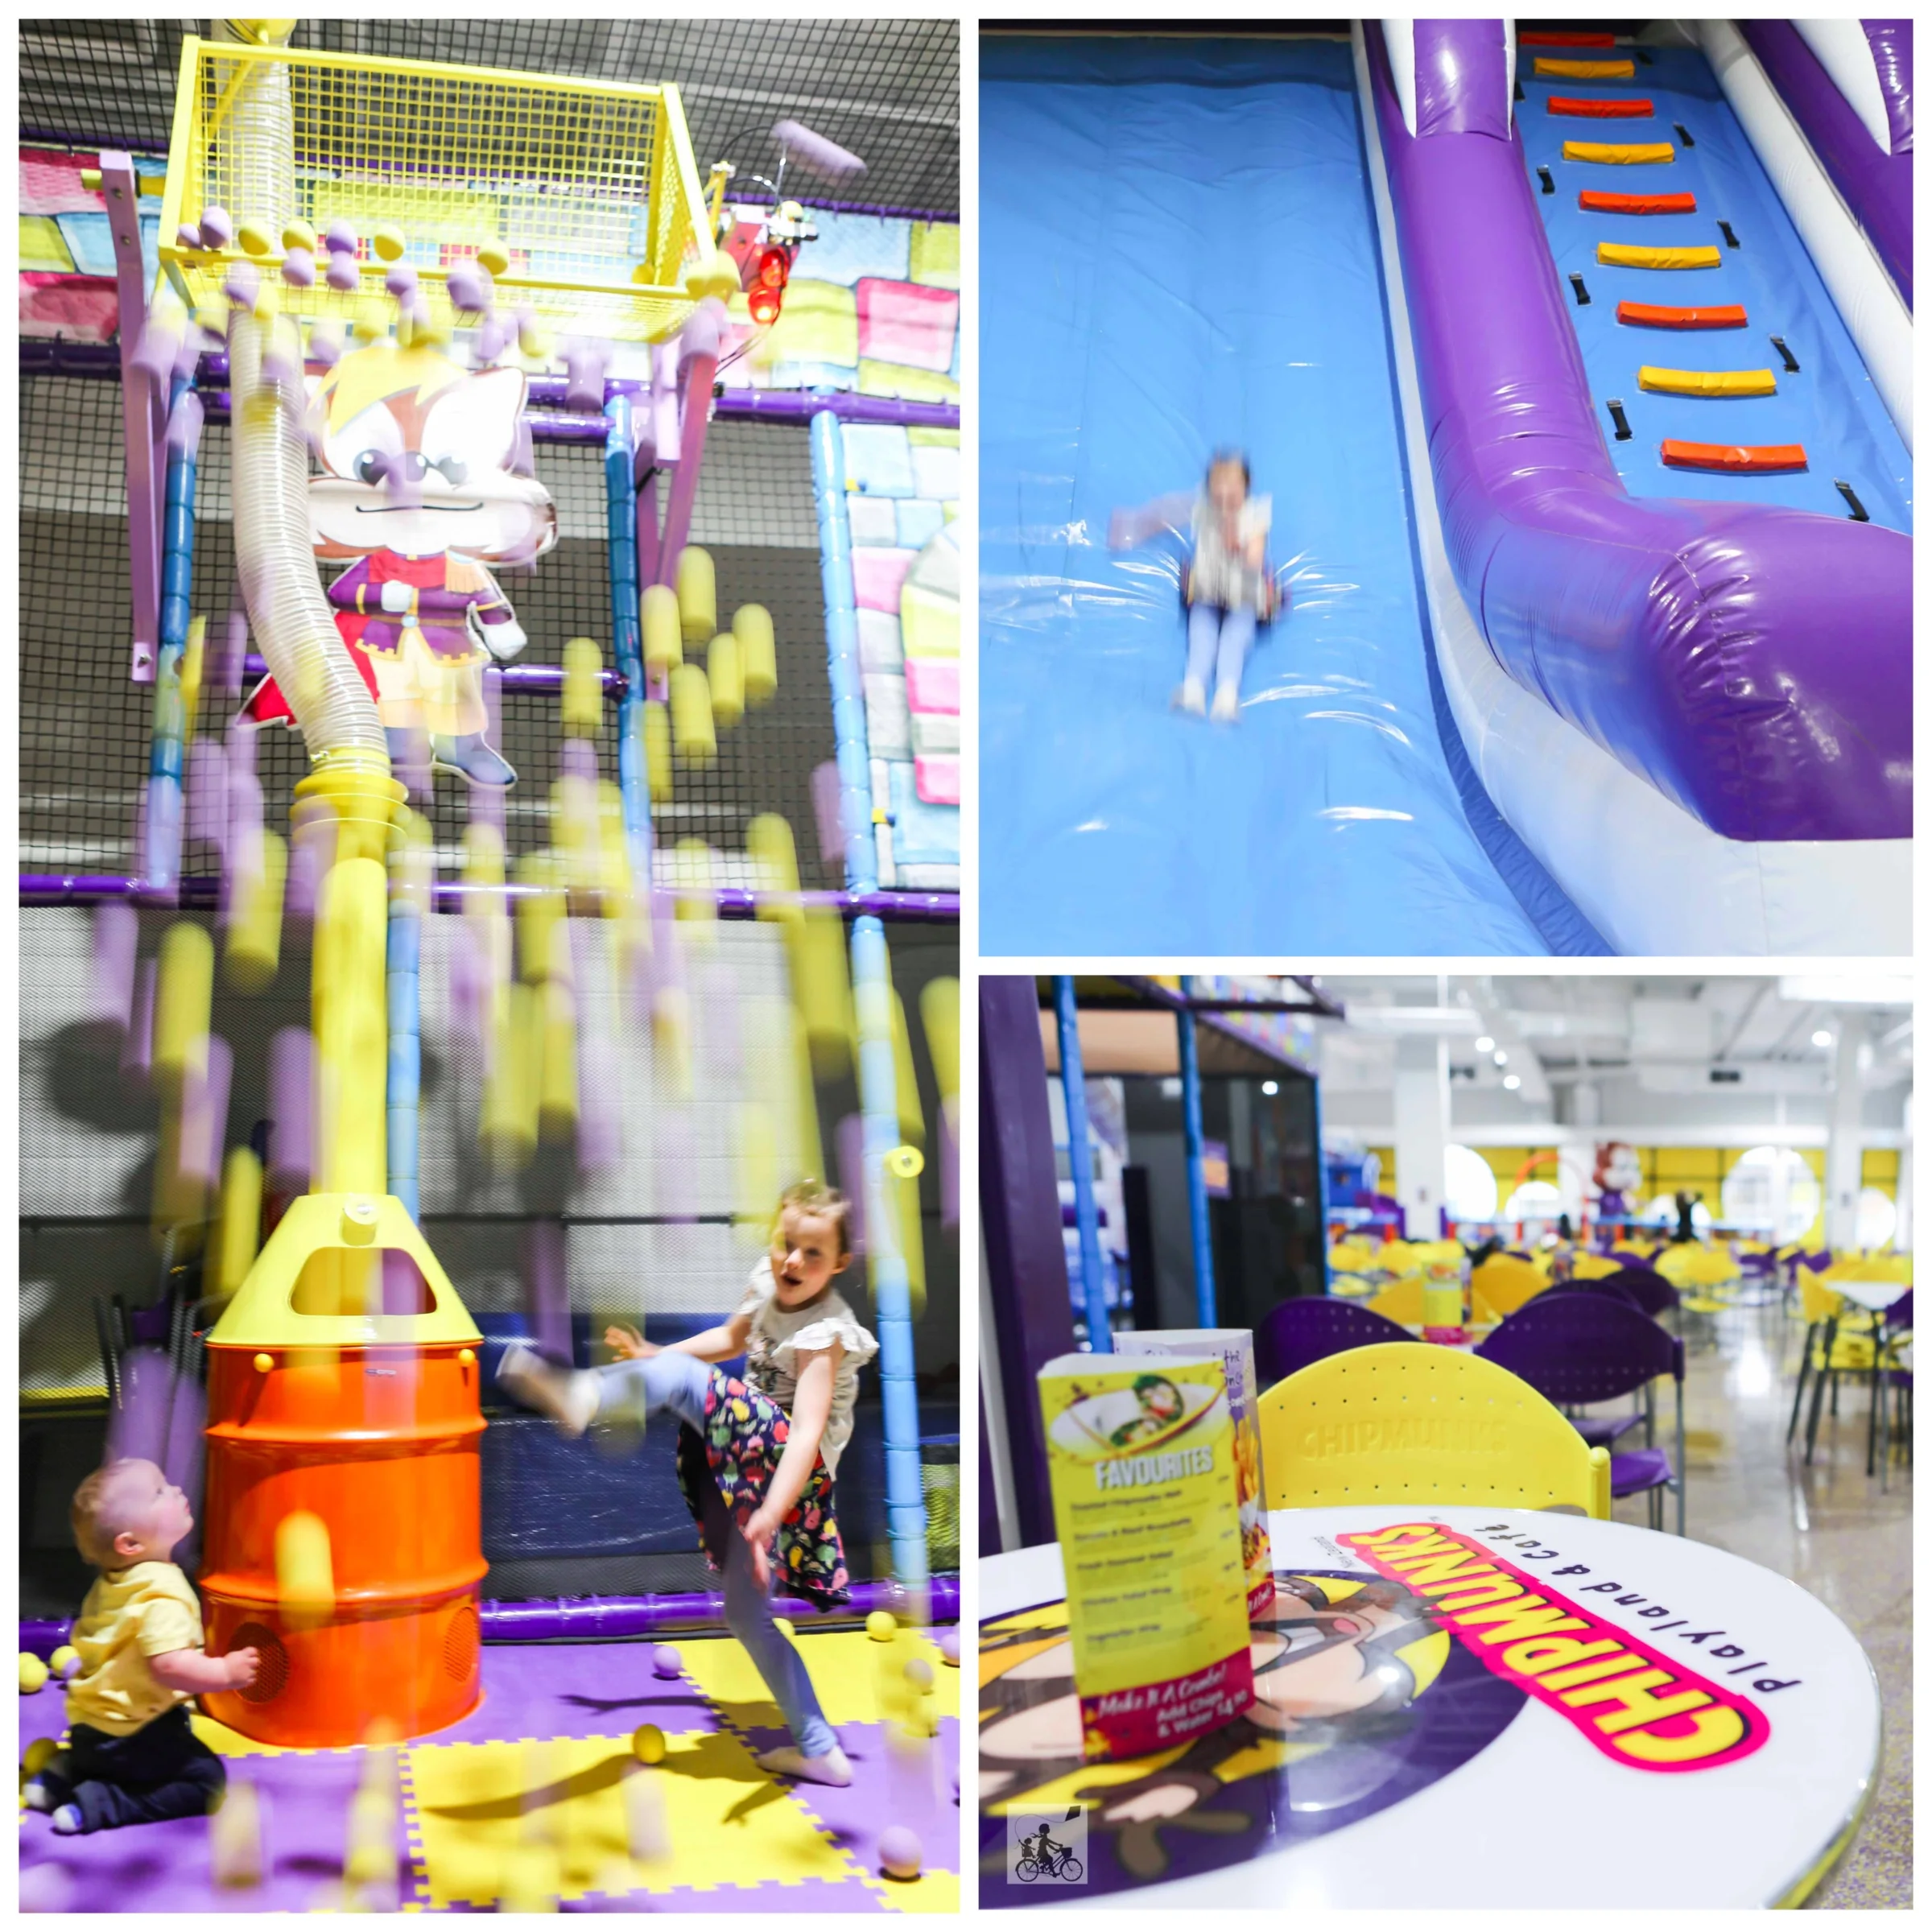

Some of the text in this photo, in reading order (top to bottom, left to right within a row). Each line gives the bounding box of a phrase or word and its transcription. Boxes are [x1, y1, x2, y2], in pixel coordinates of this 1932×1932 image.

[1297, 1418, 1508, 1461] CHIPMUNKS
[1095, 1445, 1213, 1490] FAVOURITES
[1550, 1564, 1591, 1575] &
[1349, 1525, 1751, 1762] CHIPMUNKS
[1099, 1689, 1144, 1719] Make
[1162, 1683, 1175, 1703] A
[1179, 1662, 1228, 1699] Combo!
[1158, 1724, 1170, 1739] &
[1173, 1711, 1213, 1734] Water
